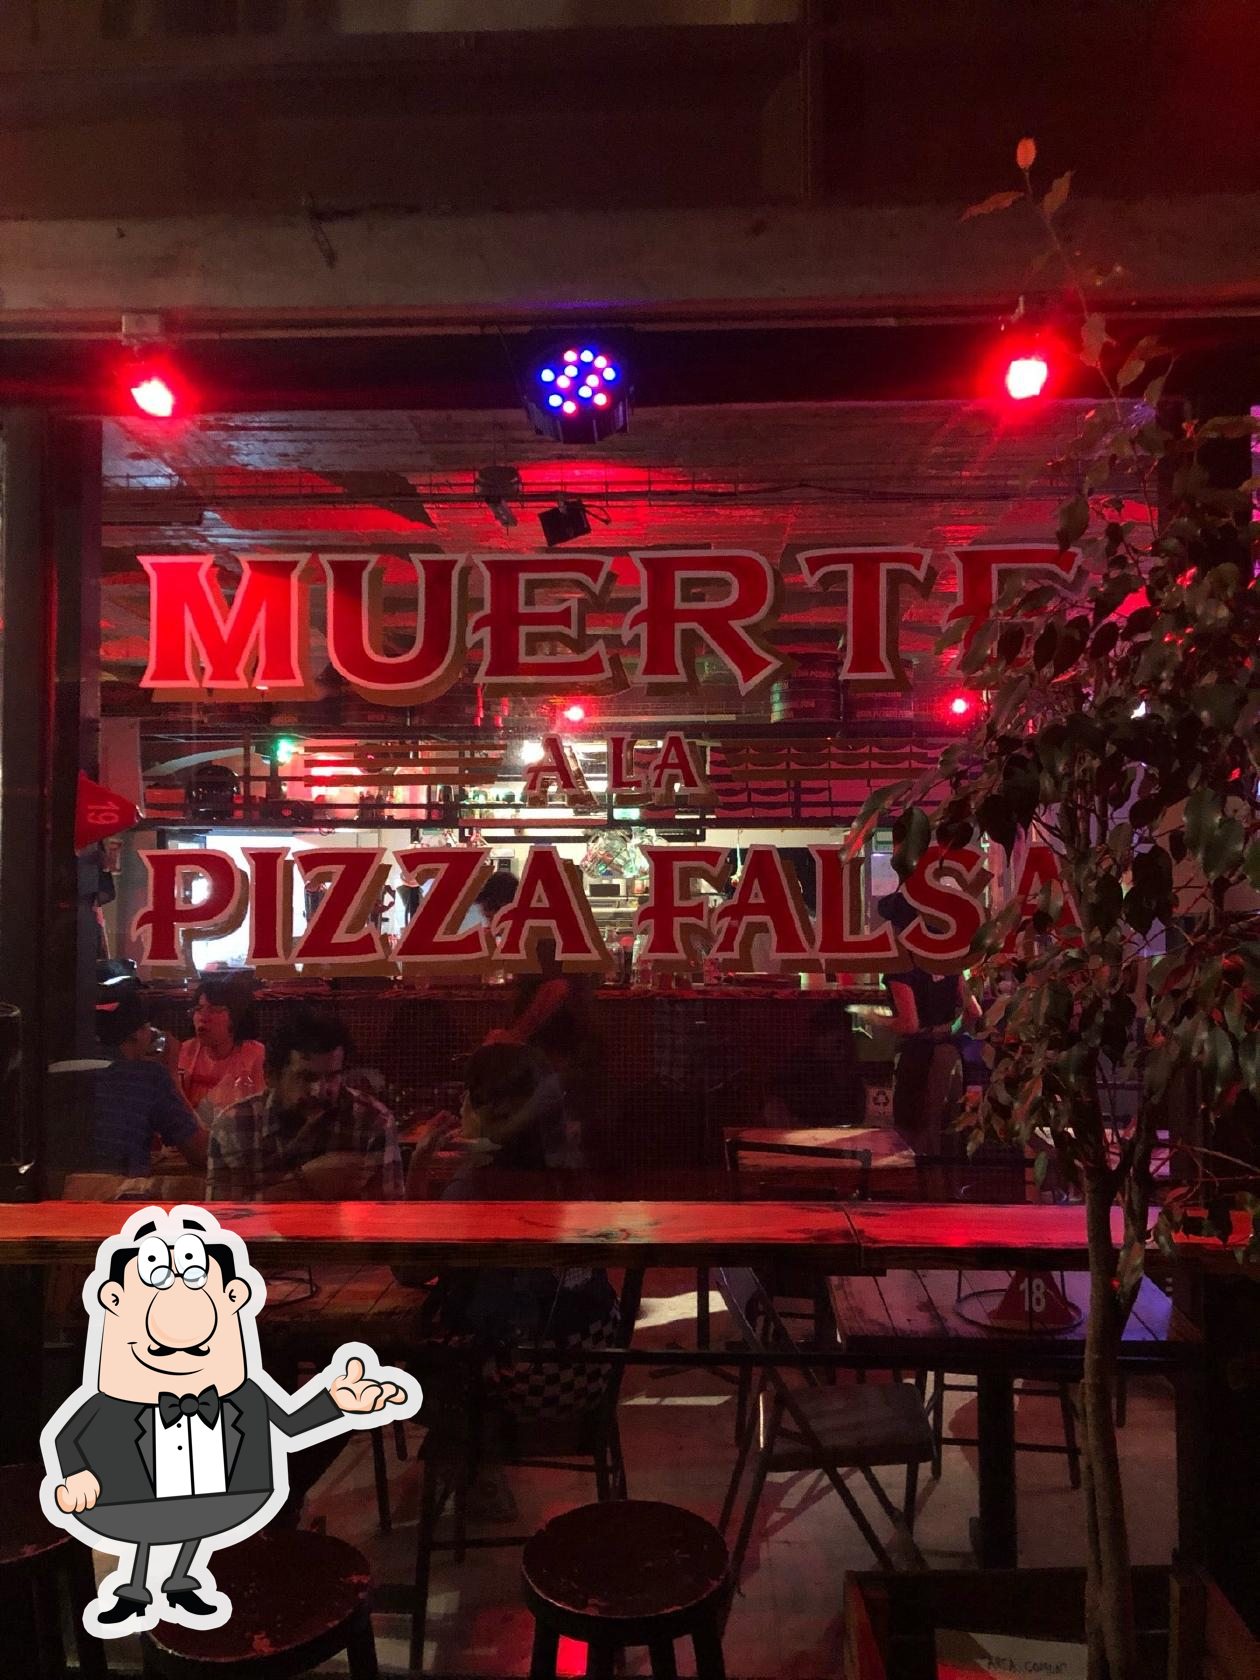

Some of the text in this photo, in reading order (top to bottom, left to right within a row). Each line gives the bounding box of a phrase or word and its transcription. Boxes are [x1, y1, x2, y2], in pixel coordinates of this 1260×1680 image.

[522, 731, 702, 792] A LA
[131, 845, 600, 966] PIZZA
[1018, 1276, 1047, 1313] 18
